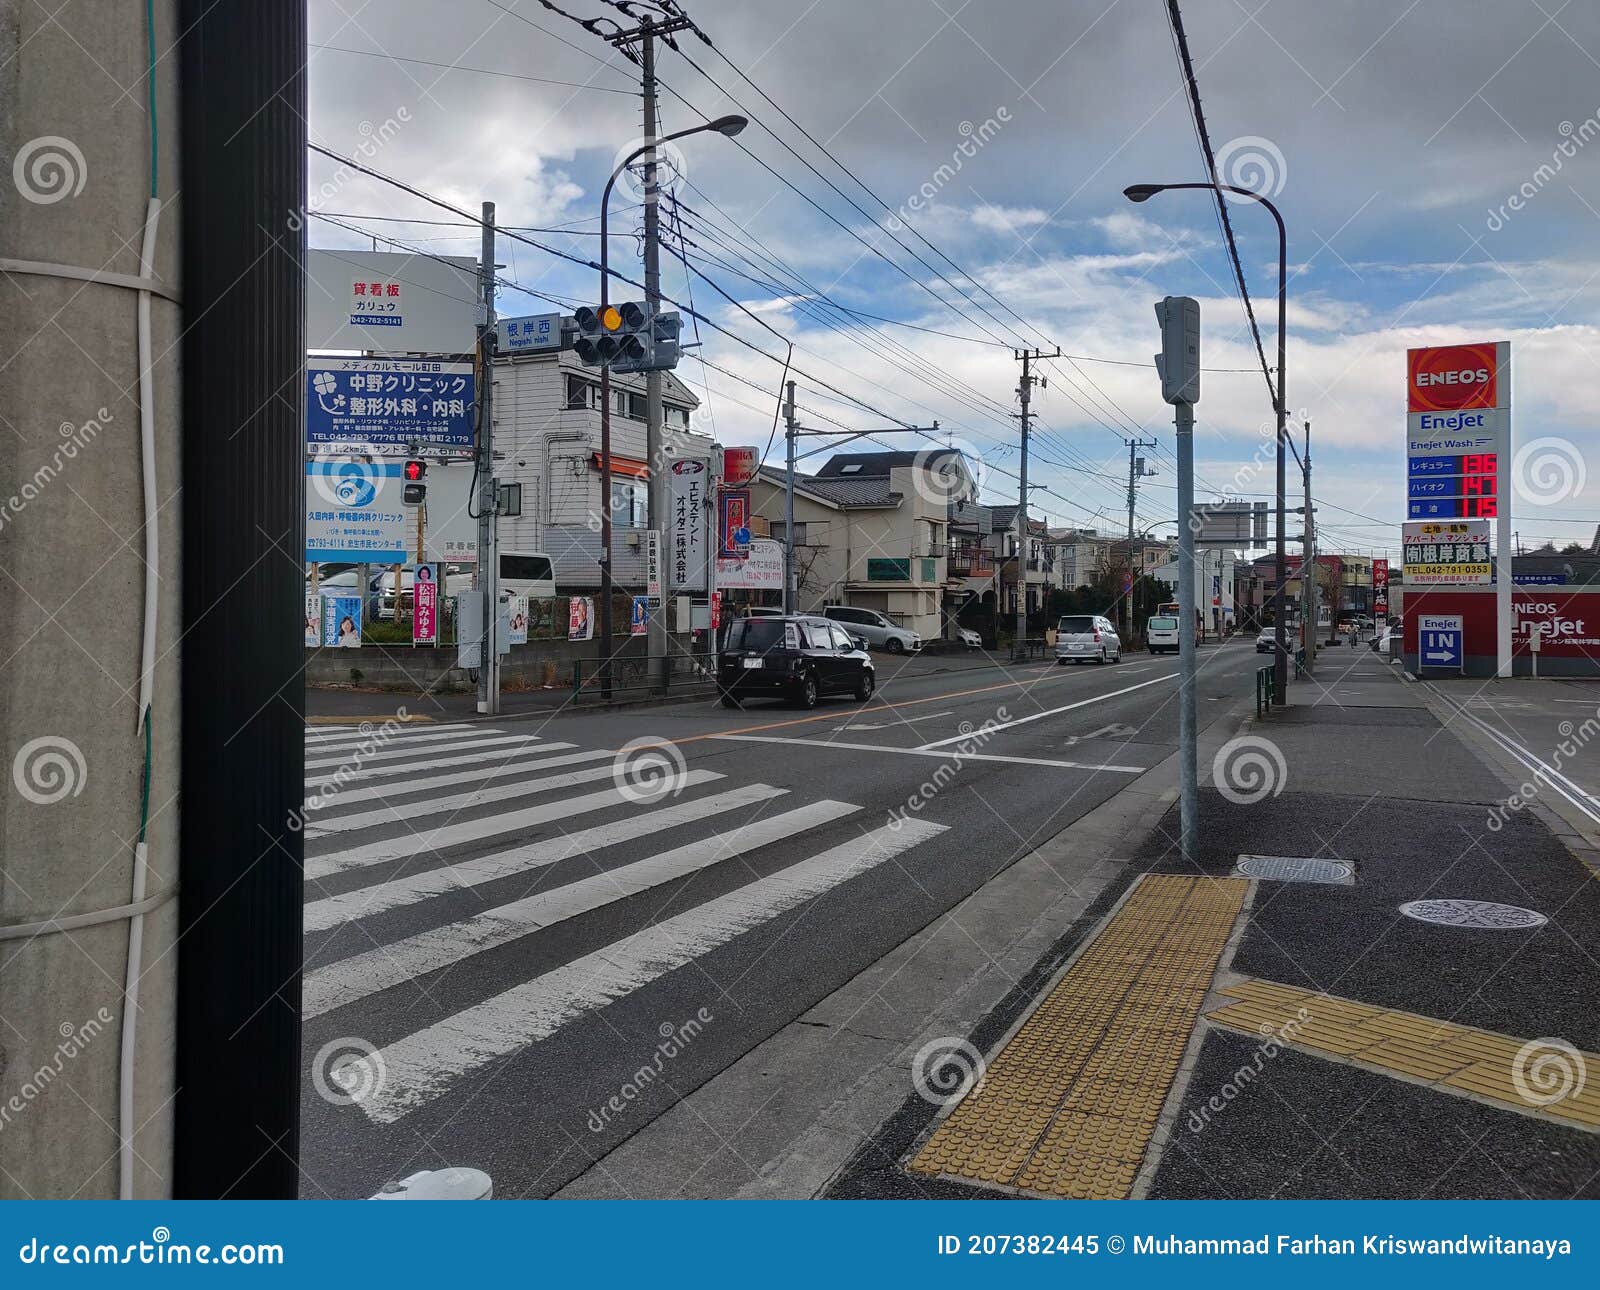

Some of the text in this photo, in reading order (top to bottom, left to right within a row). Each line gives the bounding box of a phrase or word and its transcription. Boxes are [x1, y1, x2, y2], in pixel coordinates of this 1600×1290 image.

[353, 282, 400, 296] 貸看板
[507, 320, 550, 337] 根岸西
[342, 361, 441, 372] メディカルモール町田
[350, 374, 466, 394] 中野クリニック
[1416, 368, 1489, 387] ENEOS
[350, 397, 465, 418] 整形外科・内科
[1444, 439, 1473, 448] Wash
[1412, 455, 1497, 474] レギュラー 136
[1412, 476, 1497, 495] ハイオク 147
[676, 496, 687, 584] オオタニ株式会社
[1405, 534, 1488, 543] アパート・マンション
[1511, 602, 1557, 614] NEOS
[1428, 633, 1454, 648] IN
